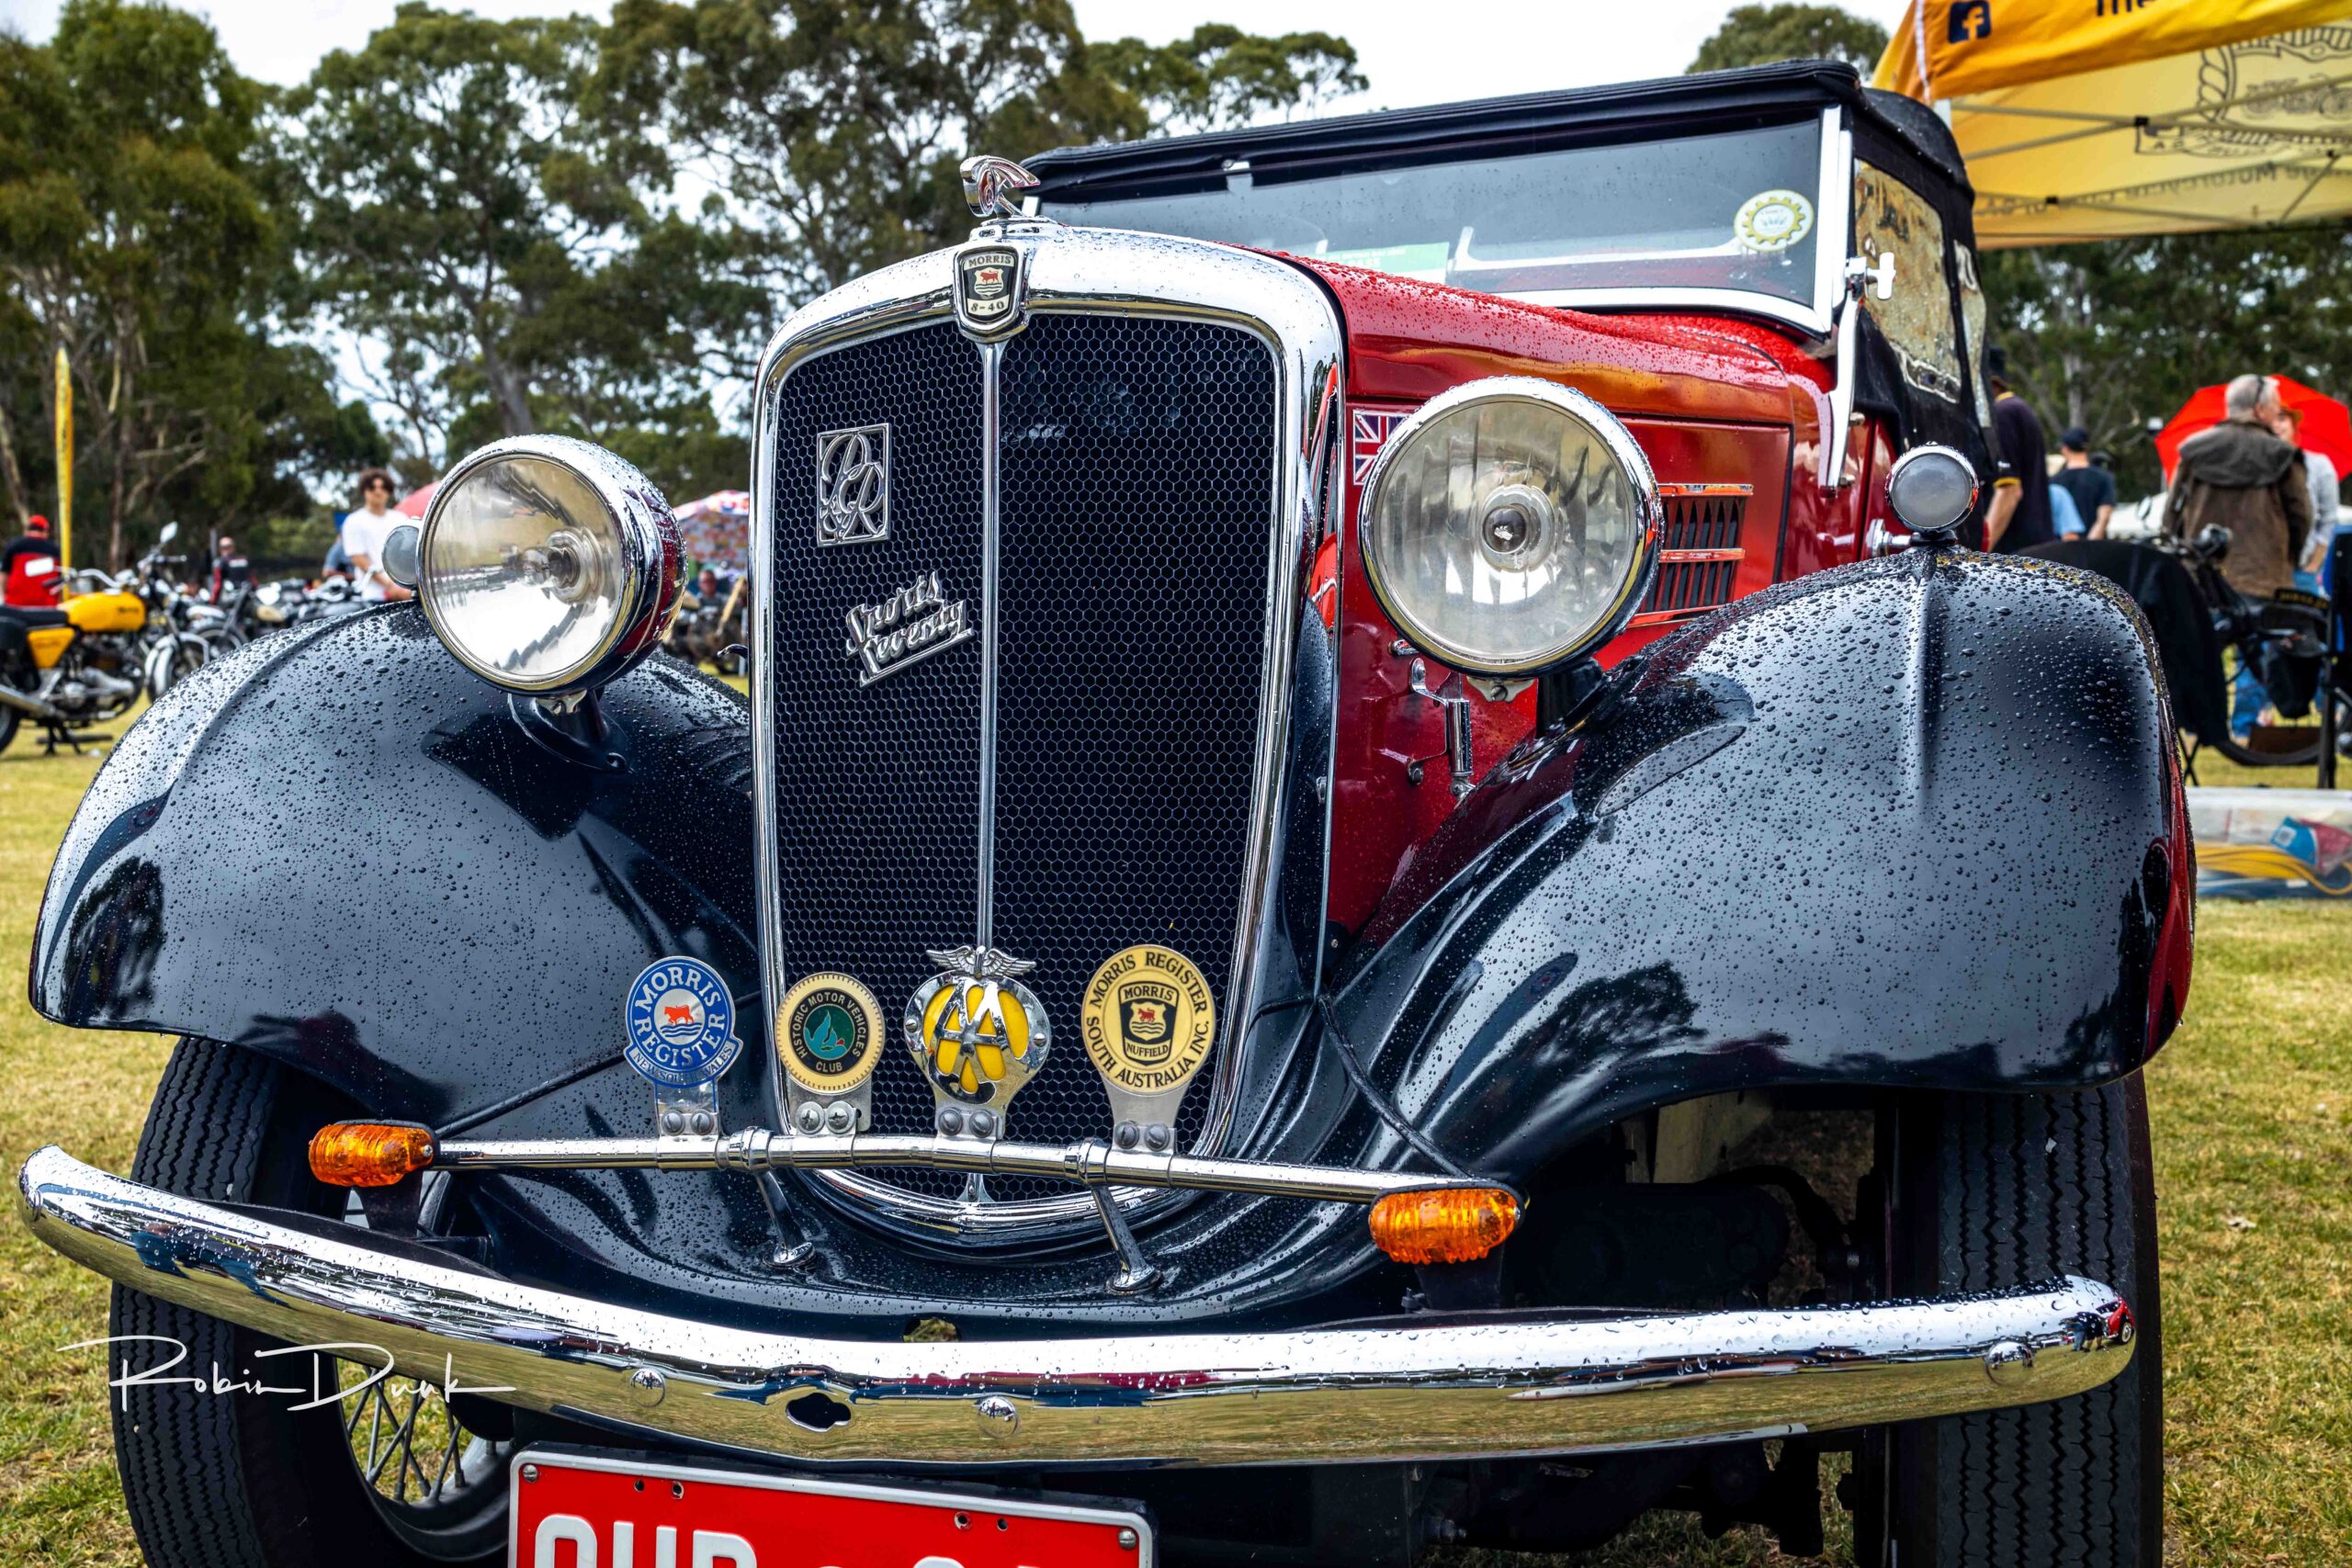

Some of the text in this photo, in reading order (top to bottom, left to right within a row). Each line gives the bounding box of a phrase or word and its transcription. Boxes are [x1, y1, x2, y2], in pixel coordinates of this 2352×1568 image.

[968, 255, 1012, 267] MORRIS
[970, 300, 1005, 312] 8-40
[846, 570, 947, 657] Sports
[635, 966, 721, 1012] MORRIS
[1089, 951, 1208, 1014] MORRIS REGISTER
[1124, 985, 1174, 1001] MORRIS
[634, 1013, 726, 1066] REGISTER
[792, 992, 866, 1059] HISTORIC MOTOR VEHICLES
[634, 1047, 733, 1083] NEW SOU WALES
[815, 1061, 842, 1073] CLUB
[1086, 1016, 1210, 1089] SOUTH AUSTRALIA INC.
[1126, 1043, 1170, 1057] NUFFIELD
